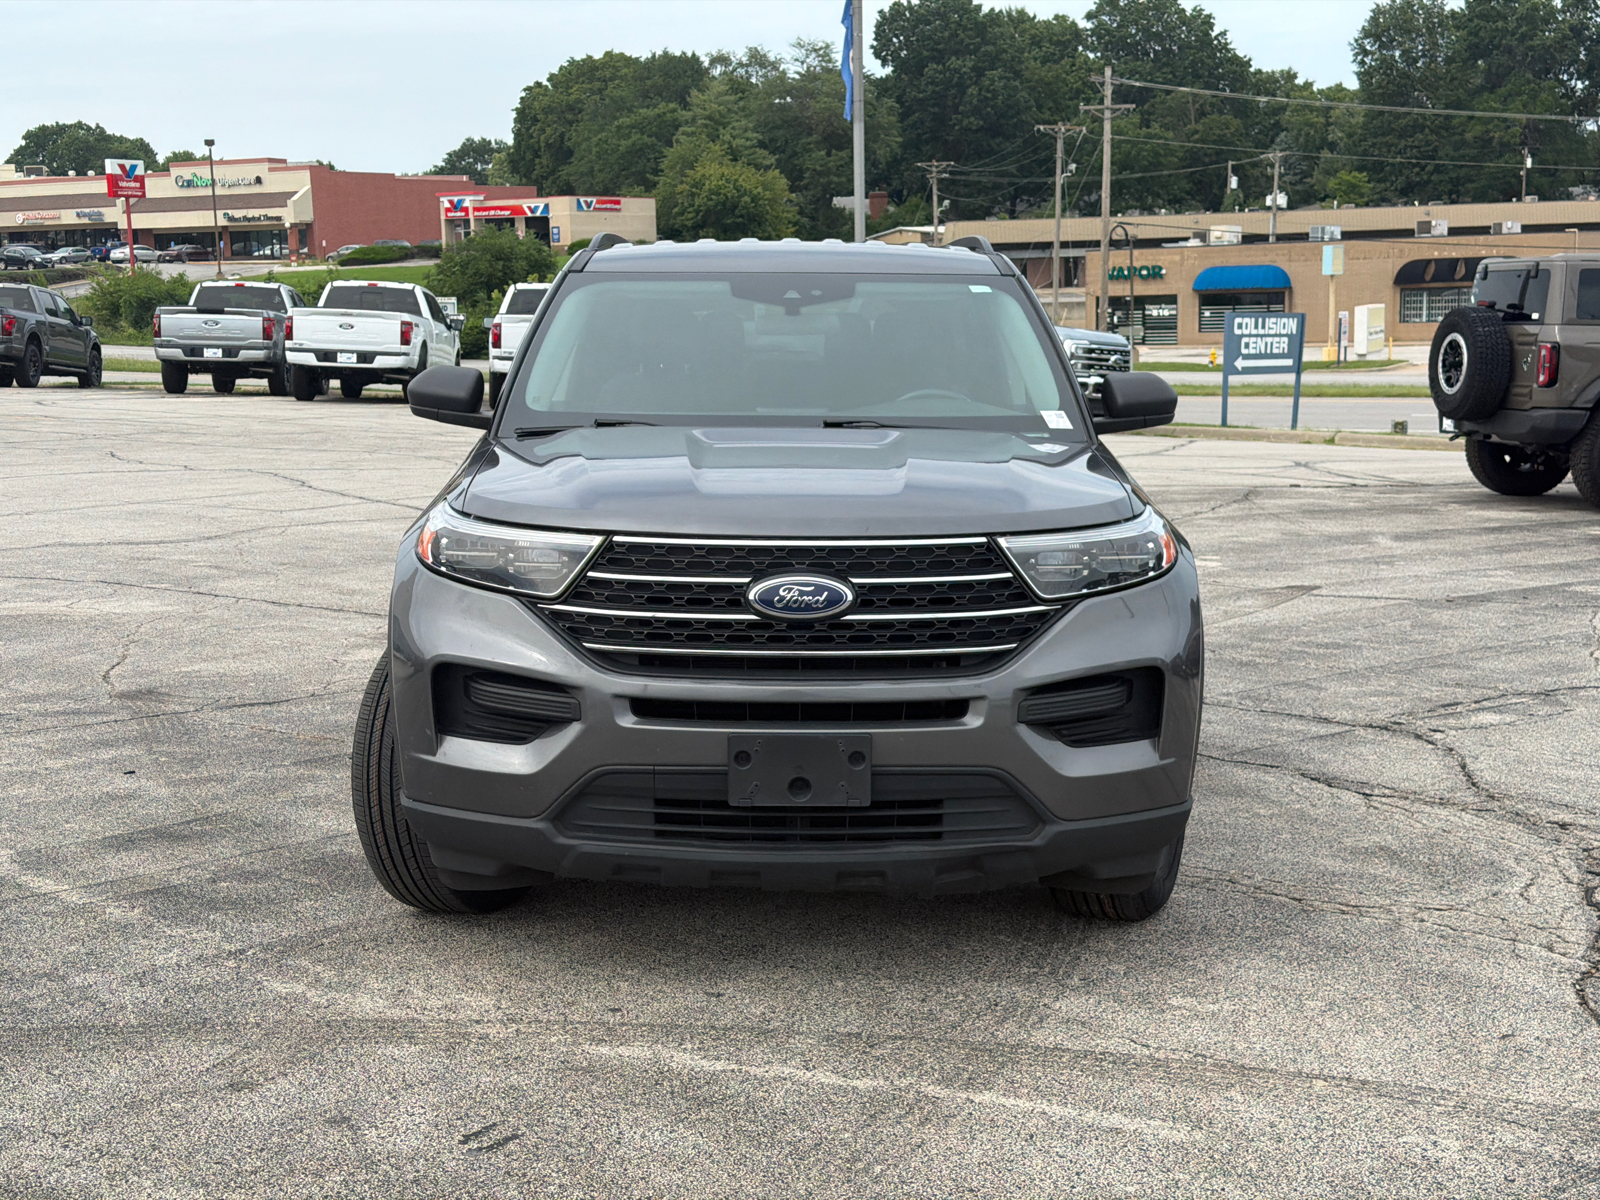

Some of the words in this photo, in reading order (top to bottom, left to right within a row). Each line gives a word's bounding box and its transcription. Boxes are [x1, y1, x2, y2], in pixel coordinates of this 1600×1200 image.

[118, 180, 141, 188] Valvoline
[217, 177, 239, 188] Urgent
[1233, 317, 1297, 335] COLLISION
[1240, 336, 1289, 354] CENTER
[773, 585, 828, 608] Ford
